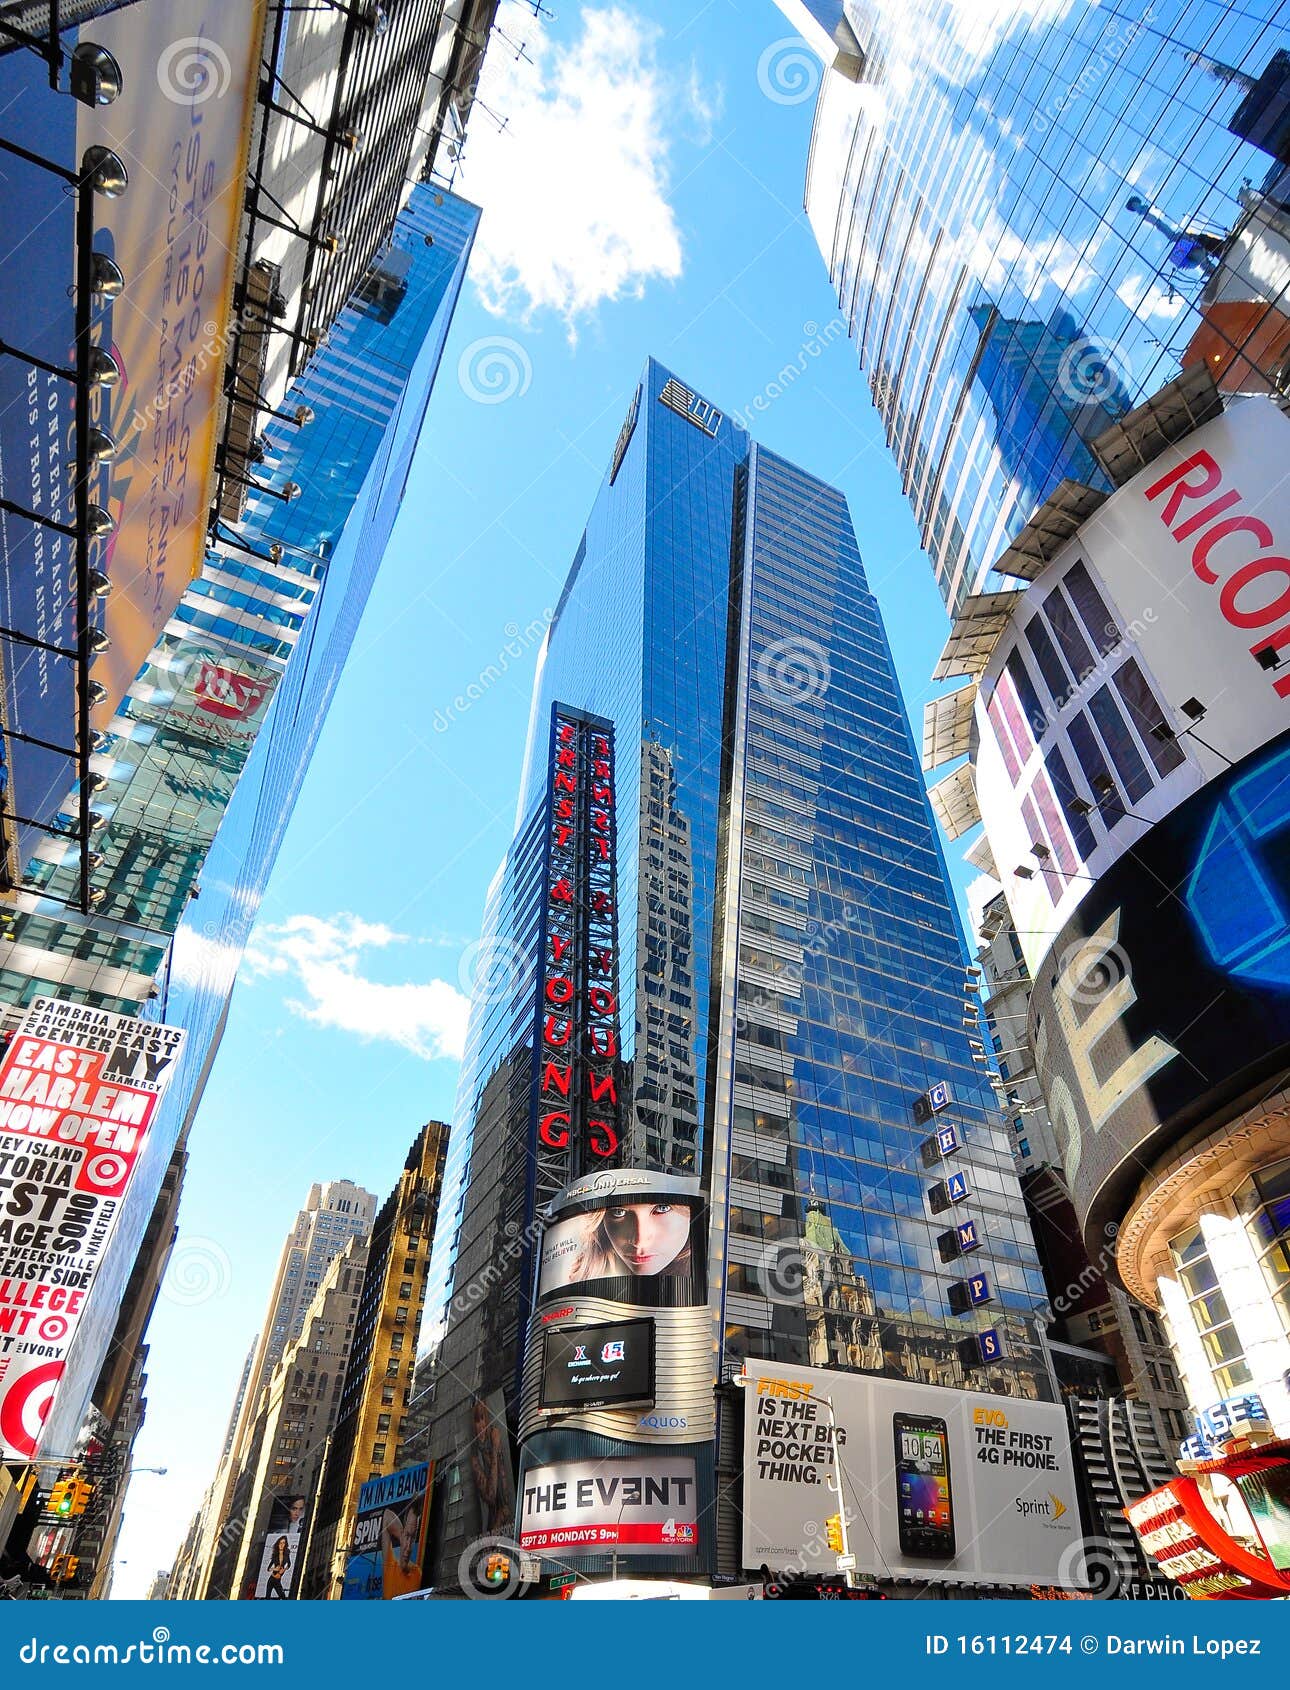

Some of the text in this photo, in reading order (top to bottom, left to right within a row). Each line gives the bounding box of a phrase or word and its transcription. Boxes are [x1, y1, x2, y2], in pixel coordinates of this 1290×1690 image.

[175, 244, 192, 305] 15
[27, 366, 38, 425] BUS
[30, 434, 42, 511] FROM
[47, 365, 63, 665] YONKERS RACEWAY
[35, 586, 48, 699] AUTHORITY
[540, 725, 577, 1147] ERNST & YOUNG
[23, 1011, 117, 1039] PORT RICHMOND
[34, 999, 182, 1043] CAMBRIA HEIGHTS
[34, 1025, 112, 1053] CENTER
[116, 1031, 178, 1057] EAST
[15, 1040, 97, 1078] EAST
[106, 1046, 173, 1083] NY
[1, 1067, 151, 1125] HARLEM
[101, 1072, 162, 1092] GRAMERCY
[0, 1102, 140, 1153] NOW OPEN
[0, 1135, 83, 1163] EY ISLAND
[592, 1177, 652, 1191] UNIVERSAL
[52, 1193, 98, 1254] SOHO
[85, 1200, 117, 1255] WAKEFIELD
[934, 1083, 996, 1357] CHAMPS
[560, 1238, 573, 1248] WILL
[9, 1246, 94, 1271] WEEKSVILLE
[50, 1268, 92, 1290] SIDE
[22, 1342, 63, 1358] IVORY
[756, 1377, 814, 1401] FIRST
[639, 1416, 687, 1429] AQUOS
[757, 1398, 817, 1421] IS THE
[757, 1418, 812, 1442] NEXT
[975, 1428, 1052, 1451] THE FIRST
[757, 1440, 836, 1465] POCKET
[977, 1448, 1060, 1471] 4G PHONE.
[757, 1461, 821, 1485] THING.
[359, 1467, 428, 1509] I'M IN A BAND
[525, 1482, 567, 1515] THE
[1015, 1498, 1050, 1517] Sprint
[354, 1516, 382, 1546] SPIN
[521, 1535, 537, 1548] SEPT
[537, 1534, 547, 1545] 20
[550, 1529, 597, 1543] MONDAYS
[661, 1518, 676, 1537] 4
